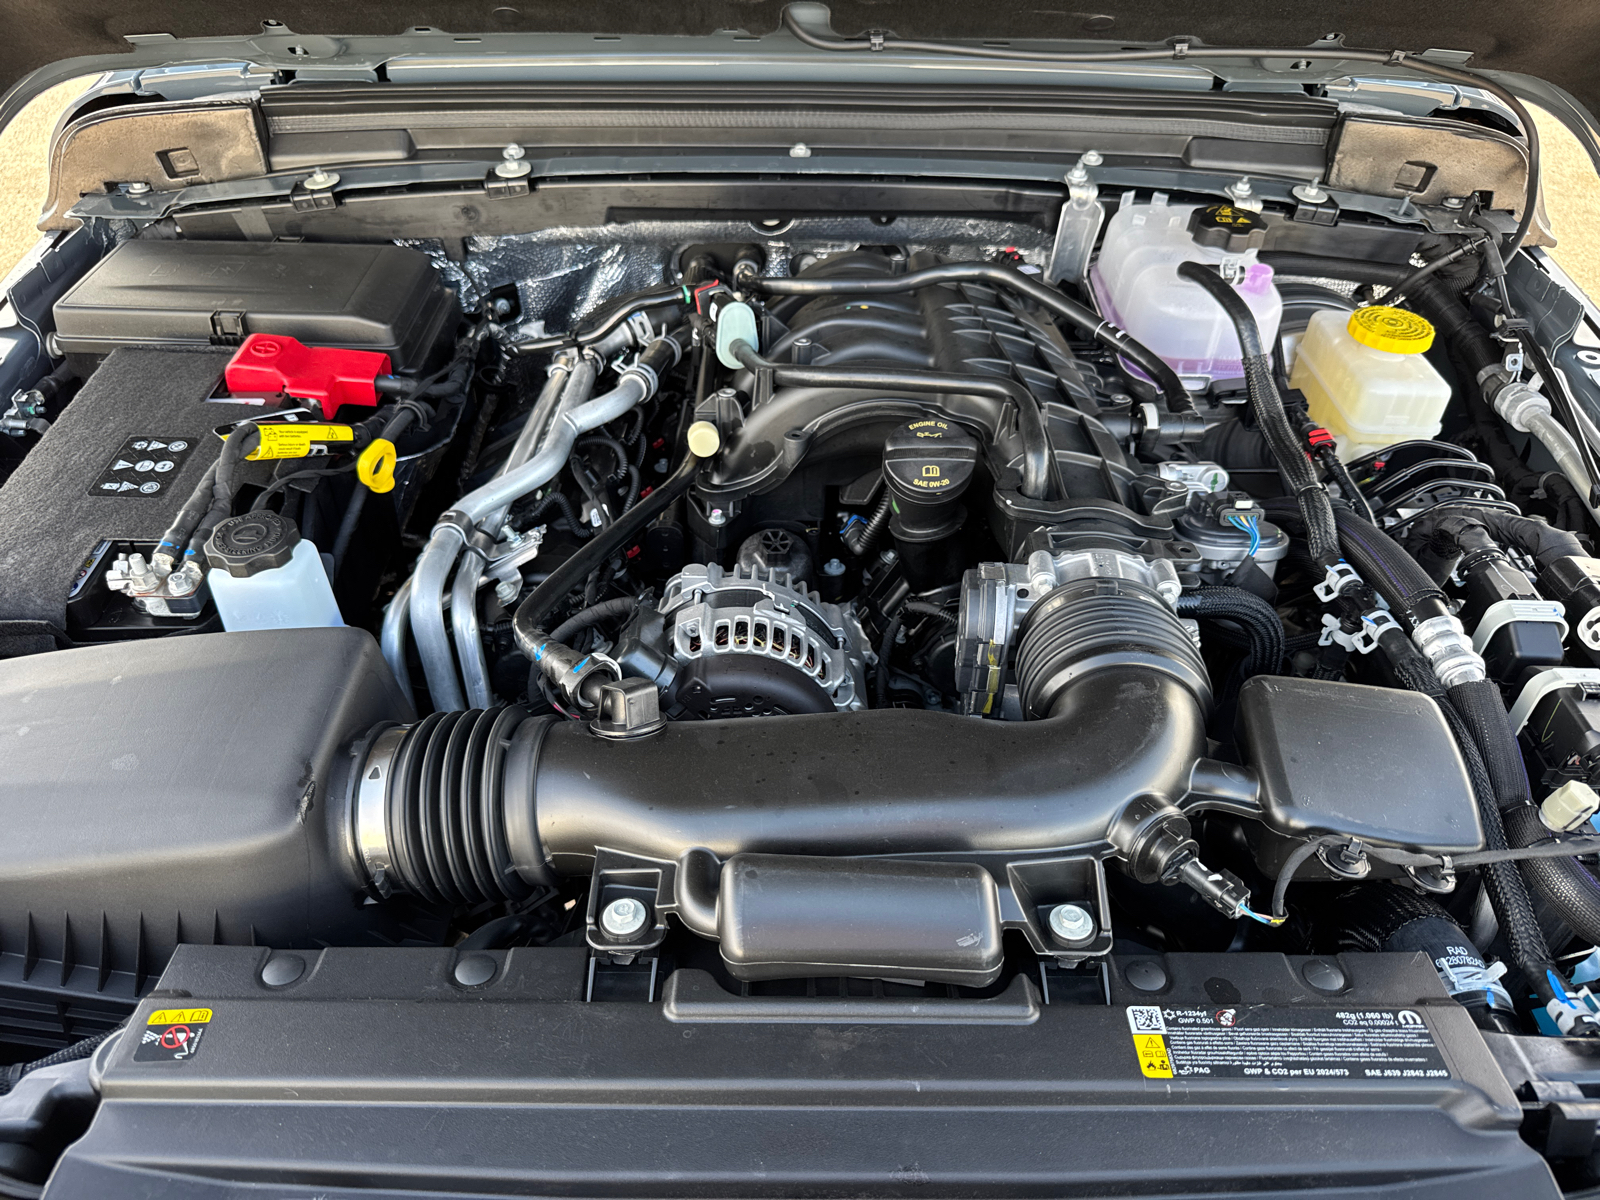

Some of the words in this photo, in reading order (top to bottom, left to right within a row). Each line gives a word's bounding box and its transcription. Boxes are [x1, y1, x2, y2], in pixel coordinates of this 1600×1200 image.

[908, 420, 936, 430] ENGINE
[936, 421, 948, 430] OIL
[912, 478, 928, 487] SAE
[928, 478, 950, 488] 0W-20
[1446, 946, 1468, 956] RAD
[1435, 956, 1486, 968] 6280782AD
